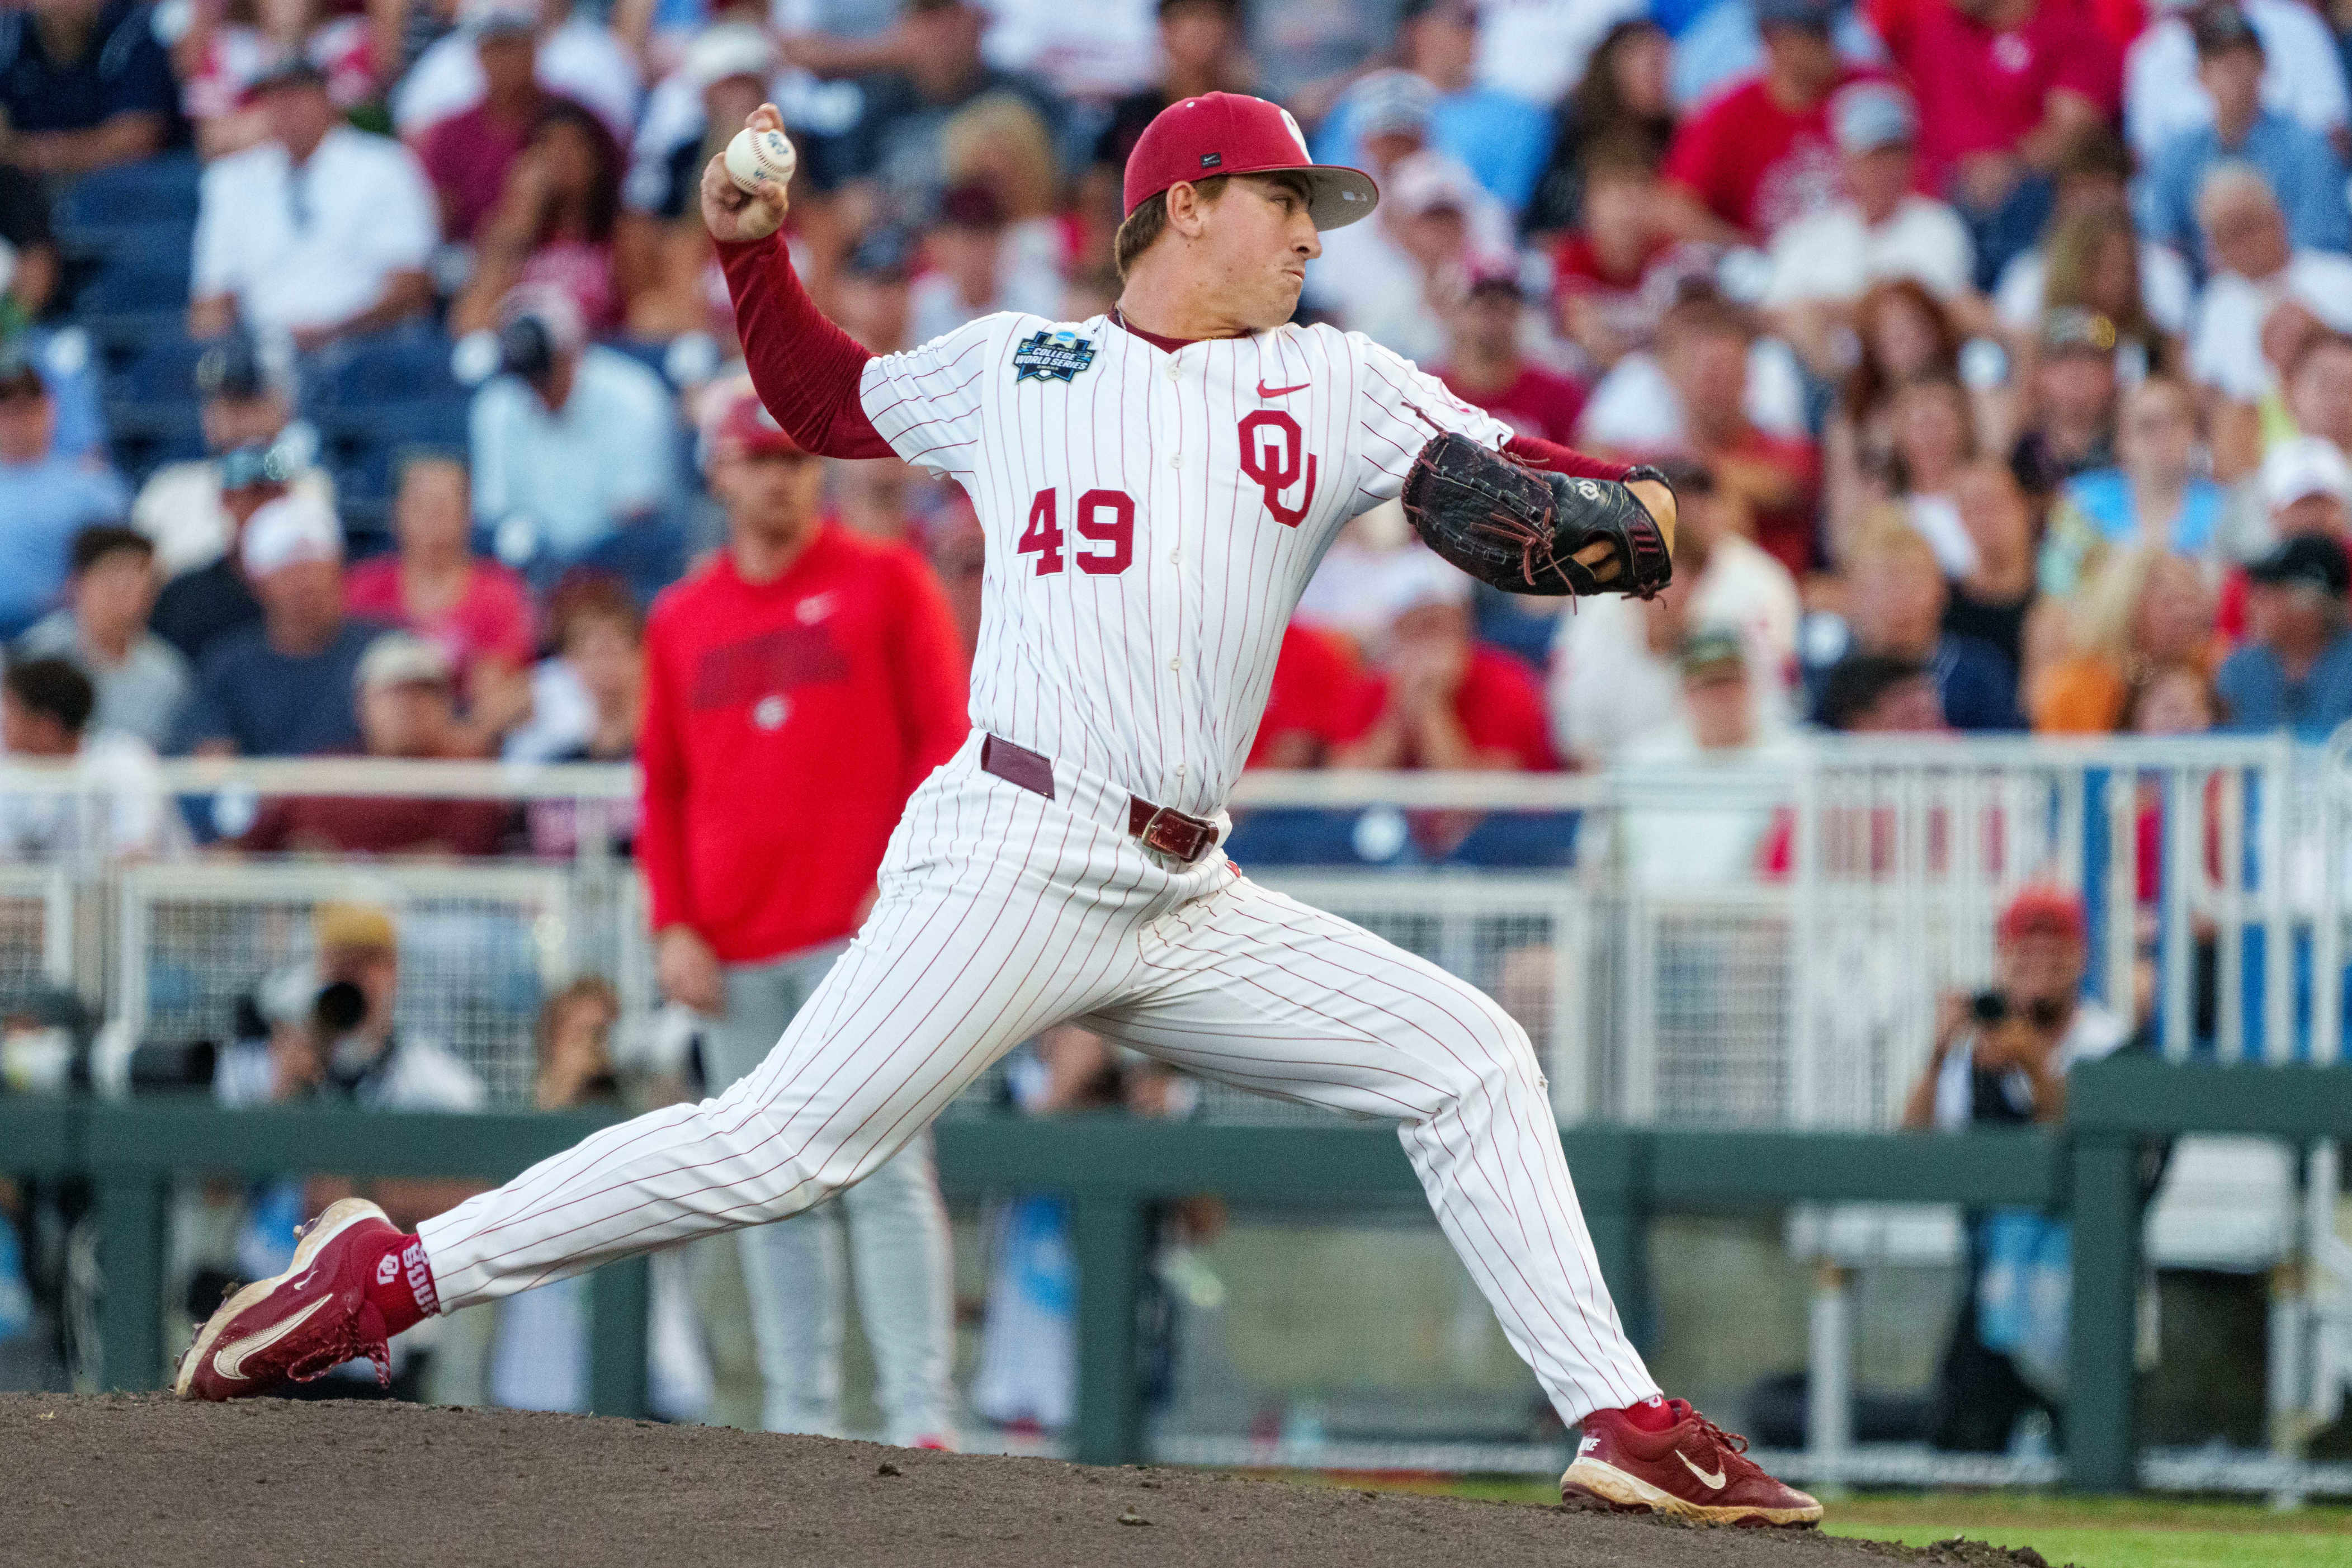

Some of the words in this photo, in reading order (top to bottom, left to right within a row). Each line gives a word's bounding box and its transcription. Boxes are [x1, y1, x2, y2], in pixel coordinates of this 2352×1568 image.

[1015, 355, 1051, 366] WORLD
[1051, 358, 1088, 370] SERIES
[1032, 347, 1077, 361] COLLEGE
[1237, 409, 1317, 528] OU
[1016, 487, 1136, 577] 49
